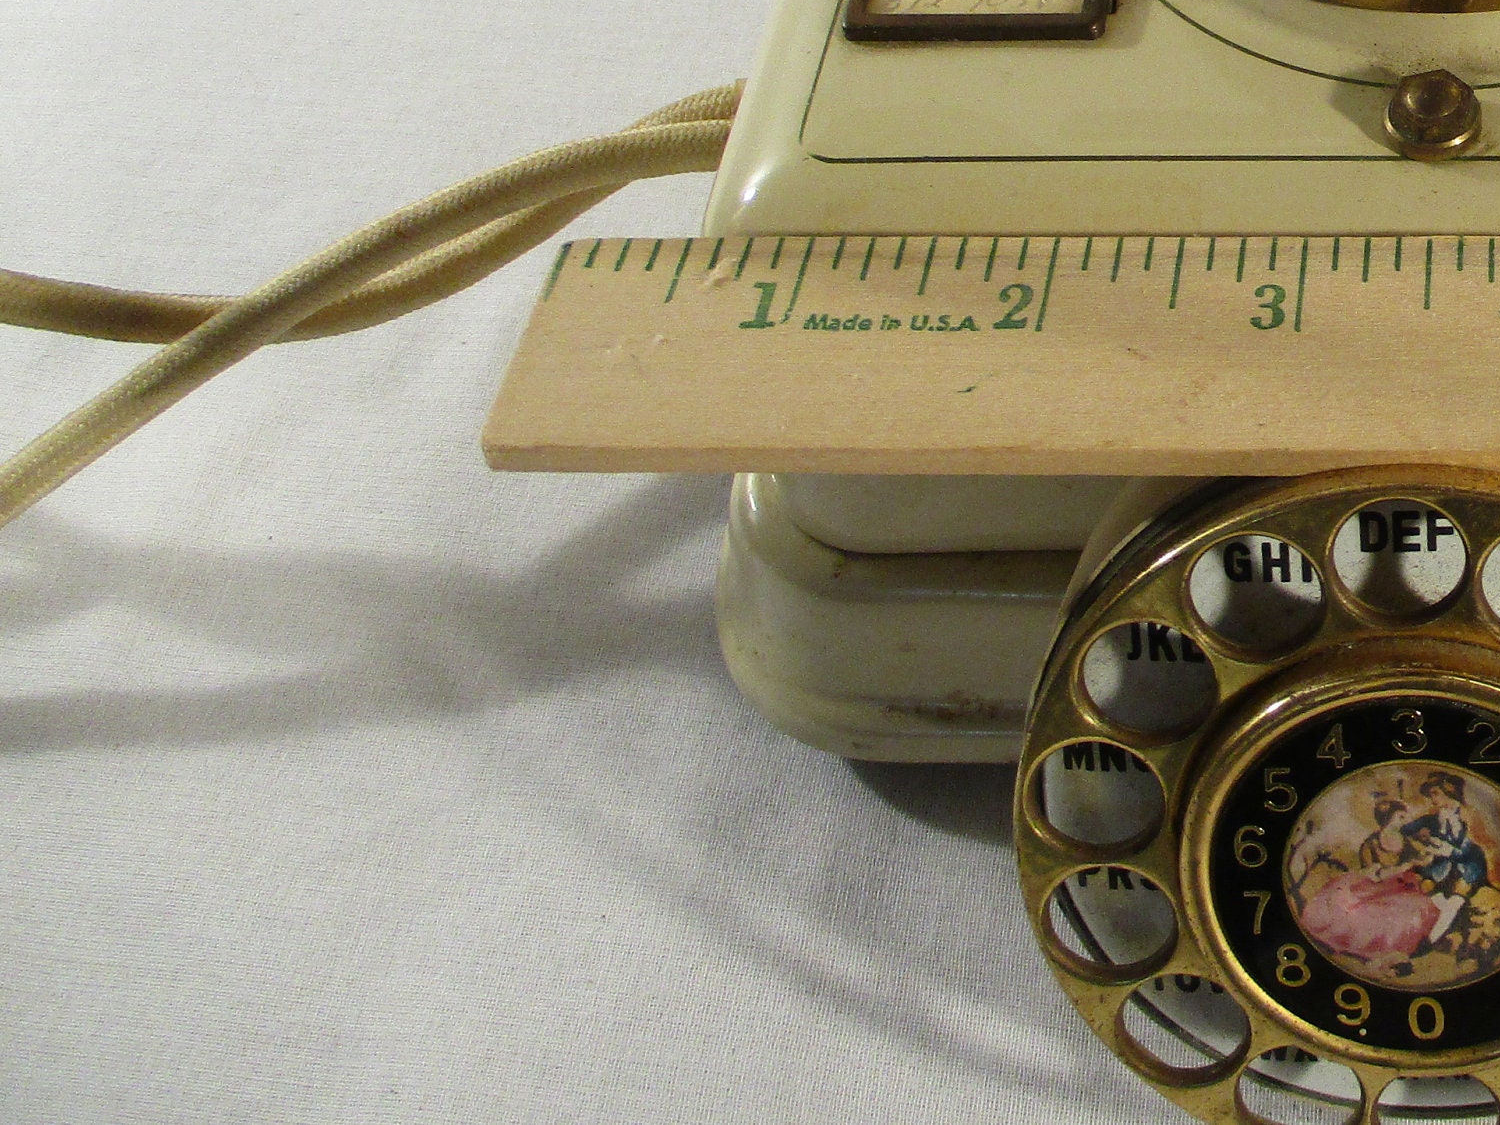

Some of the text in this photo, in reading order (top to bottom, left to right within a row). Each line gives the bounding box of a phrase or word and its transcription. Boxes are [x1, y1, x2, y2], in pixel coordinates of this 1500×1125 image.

[739, 283, 777, 329] 1
[993, 284, 1034, 329] 2
[1250, 285, 1287, 330] 3
[803, 314, 873, 331] Made
[880, 315, 901, 330] in
[1358, 510, 1454, 553] DEF
[1316, 723, 1352, 768] 4
[1391, 710, 1428, 754] 3
[1264, 767, 1298, 812] 5
[1234, 825, 1268, 868] 6
[1243, 890, 1272, 935] 7
[1275, 943, 1311, 988] 8
[1333, 982, 1371, 1026] 9
[1408, 997, 1445, 1040] 0
